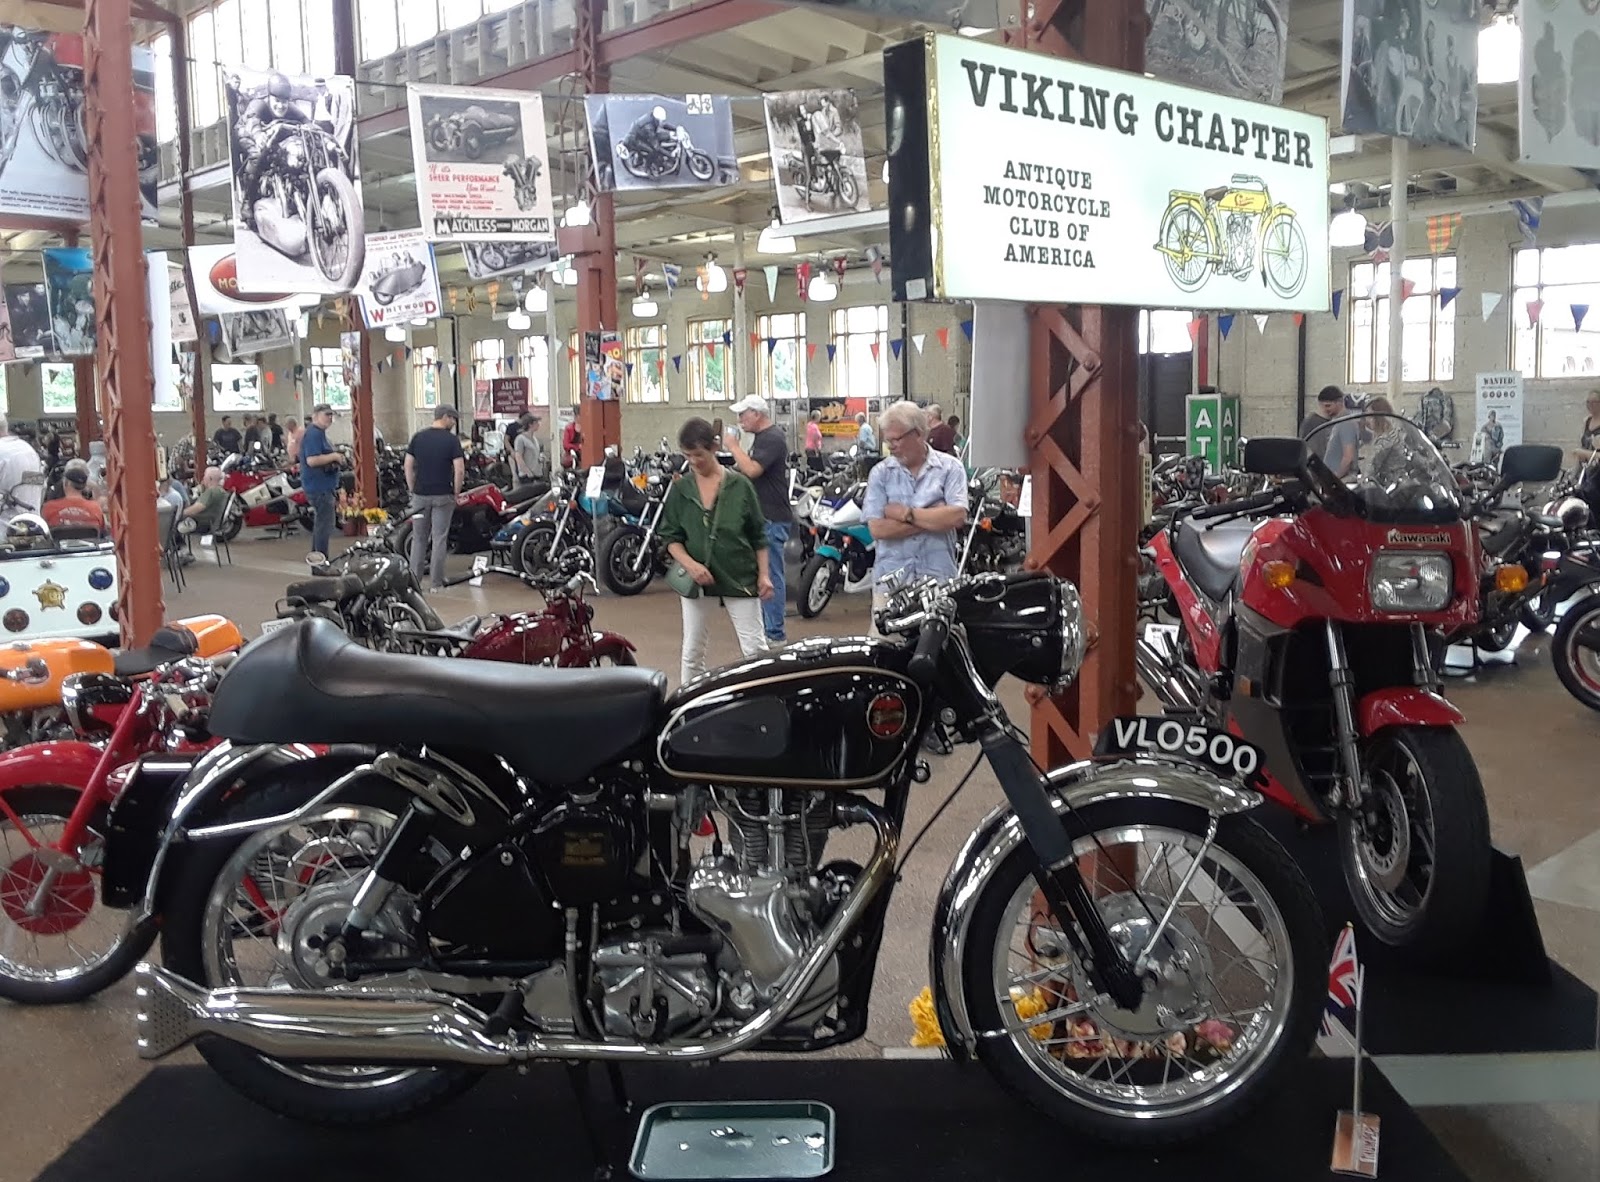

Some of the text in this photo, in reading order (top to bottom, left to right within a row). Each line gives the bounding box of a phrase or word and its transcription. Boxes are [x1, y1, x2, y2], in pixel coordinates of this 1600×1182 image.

[961, 59, 1313, 169] VIKING CHAPTER
[1003, 160, 1092, 190] ANTIQUE
[983, 185, 1110, 218] MOTORCYCLE
[437, 218, 549, 235] MATCHLESS MORGAN
[1010, 216, 1089, 242] CLUB OF
[1003, 243, 1096, 268] AMERICA
[370, 300, 437, 323] WHITWOOD
[1388, 528, 1452, 544] Kawasaki
[1114, 718, 1257, 776] VLO500
